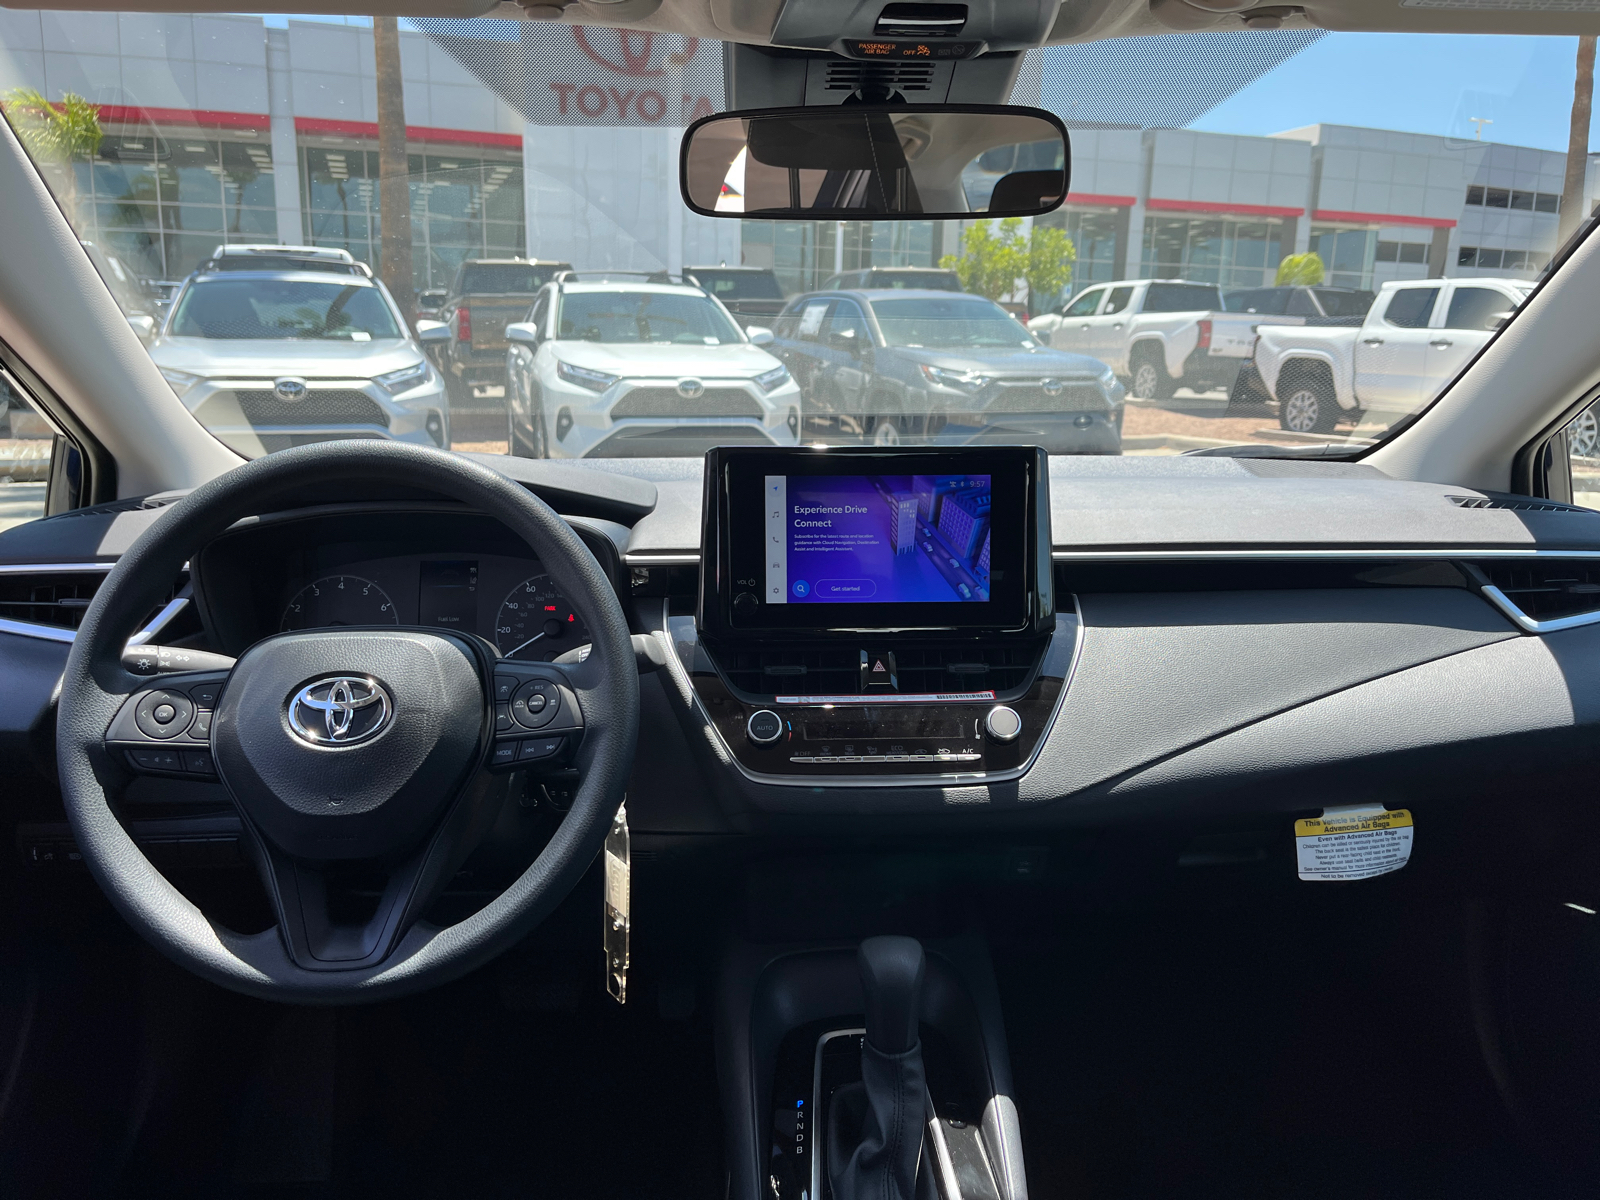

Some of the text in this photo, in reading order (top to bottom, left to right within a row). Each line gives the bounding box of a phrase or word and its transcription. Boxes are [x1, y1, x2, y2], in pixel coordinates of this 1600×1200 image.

[969, 480, 986, 488] 9:57
[794, 505, 868, 516] Experience Drive
[794, 519, 832, 528] Connect
[338, 582, 345, 590] 4
[526, 585, 536, 593] 60
[362, 587, 369, 596] 5
[294, 604, 301, 613] 2
[380, 604, 387, 612] 6
[500, 626, 511, 634] 20
[1322, 817, 1348, 826] Vehicle
[1357, 813, 1390, 823] Equipped
[1324, 821, 1390, 833] Advanced Air Bags
[796, 1100, 804, 1108] P
[796, 1146, 803, 1154] B
